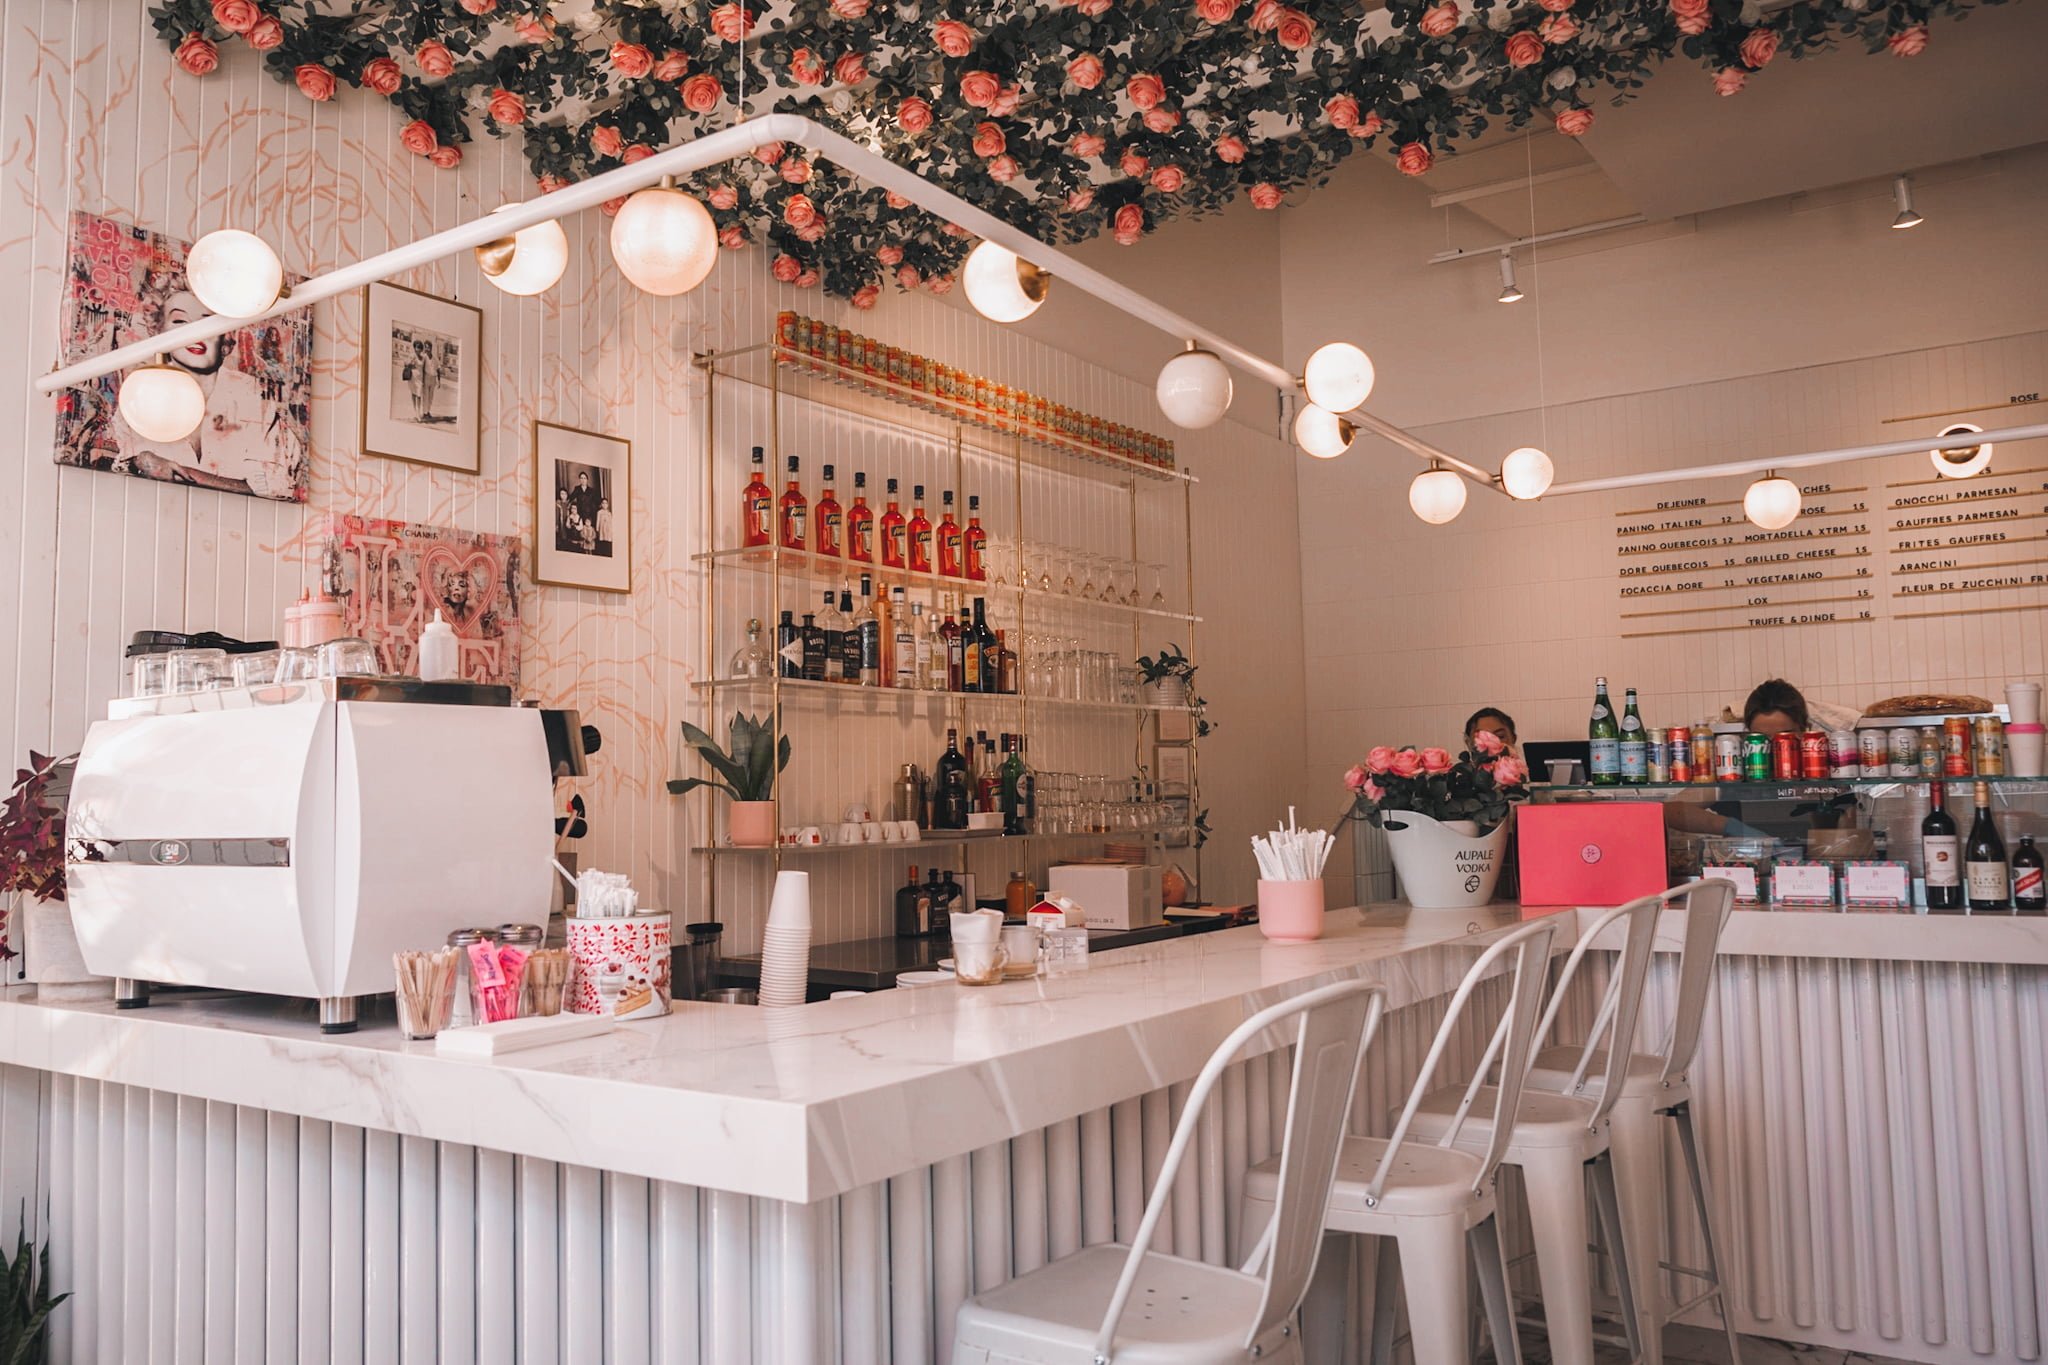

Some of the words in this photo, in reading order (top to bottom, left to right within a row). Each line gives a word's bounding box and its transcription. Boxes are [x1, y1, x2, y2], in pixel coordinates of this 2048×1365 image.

[2010, 393, 2039, 404] ROSE
[1657, 498, 1706, 510] DEJEUNER
[1895, 494, 1949, 506] GNOCCHI
[1956, 486, 2017, 500] PARMESAN
[1853, 502, 1865, 510] 15
[1617, 524, 1655, 534] PANINO
[1661, 519, 1702, 529] ITALIEN
[1721, 516, 1732, 524] 12
[1896, 515, 1952, 528] GAUFFRES
[1958, 509, 2018, 521] PARMESAN
[1745, 529, 1813, 542] MORTADELLA
[1819, 526, 1848, 535] XTRM
[1854, 524, 1866, 532] 15
[1898, 538, 1940, 550] FRITES
[1949, 532, 2006, 545] GAUFFRES
[1618, 544, 1656, 553] PANINO
[1660, 538, 1717, 550] QUEBECOIS
[1745, 553, 1790, 564] GRILLED
[1796, 548, 1836, 559] CHEESE
[1855, 546, 1867, 554] 15
[1620, 566, 1647, 576] DORE
[1652, 561, 1709, 573] QUEBECOIS
[1724, 558, 1735, 566] 15
[1899, 559, 1957, 571] ARANCINI
[1746, 571, 1823, 584] VEGETARIANO
[1856, 567, 1868, 575] 16
[1621, 584, 1671, 595] FOCACCIA
[1677, 582, 1703, 591] DORE
[1724, 579, 1734, 587] 11
[1901, 583, 1934, 593] FLEUR
[1940, 582, 1955, 590] DE
[1962, 576, 2023, 589] ZUCCHINI
[1748, 597, 1768, 606] LOX
[1857, 589, 1869, 597] 15
[1748, 616, 1784, 627] TRUFFE
[1790, 615, 1797, 624] &
[1800, 613, 1835, 623] DINDE
[1859, 610, 1870, 619] 16
[1455, 849, 1494, 861] AUPALE
[1456, 863, 1491, 874] VODKA
